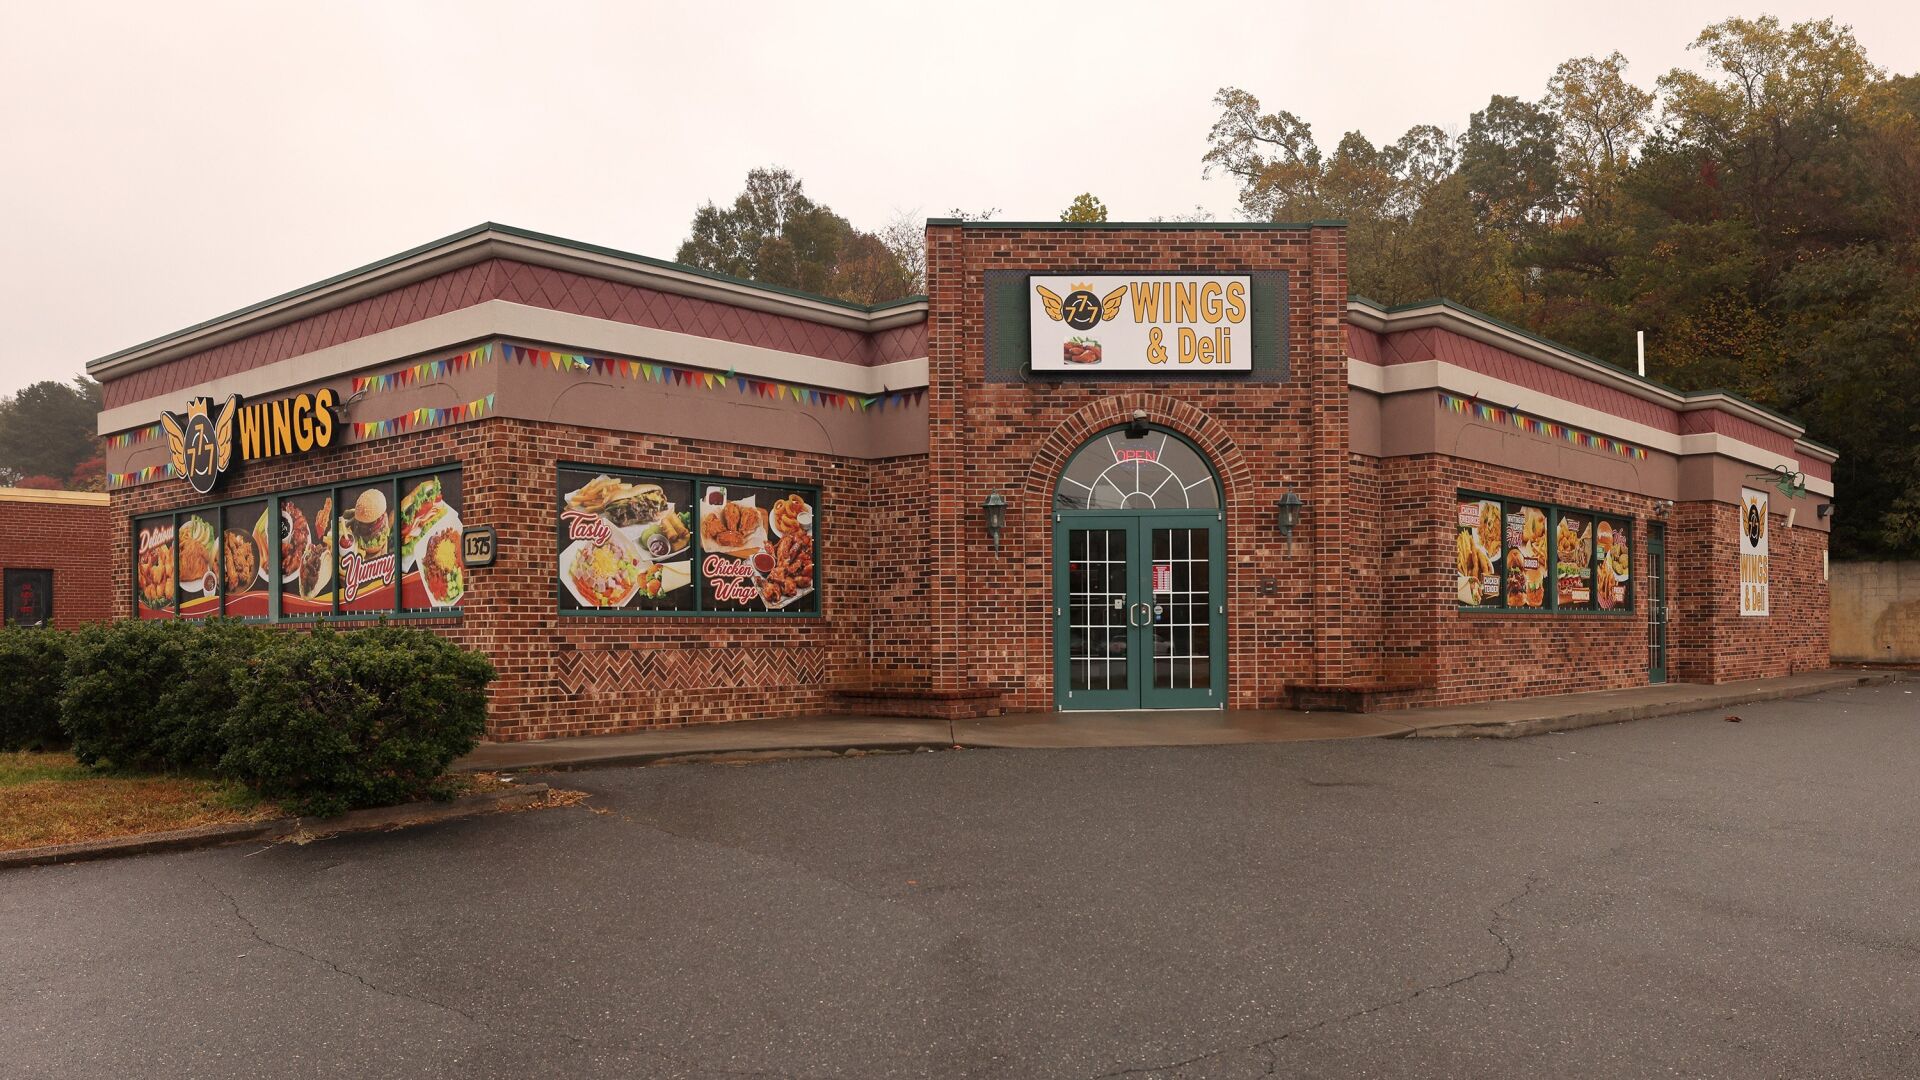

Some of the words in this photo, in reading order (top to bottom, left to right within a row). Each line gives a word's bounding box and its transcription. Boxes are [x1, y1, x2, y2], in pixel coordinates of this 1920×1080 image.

[1130, 281, 1246, 324] WINGS
[1146, 327, 1168, 364] &
[1178, 327, 1232, 364] Deli
[238, 388, 332, 460] WINGS
[1115, 448, 1157, 464] OPEN
[561, 511, 611, 547] Tasty
[466, 535, 490, 556] 1375
[342, 553, 395, 601] Yummy
[702, 554, 754, 578] Chicken
[1740, 553, 1767, 584] WINGS
[710, 577, 758, 605] Wings
[1745, 585, 1750, 611] &
[1752, 585, 1765, 611] Deli
